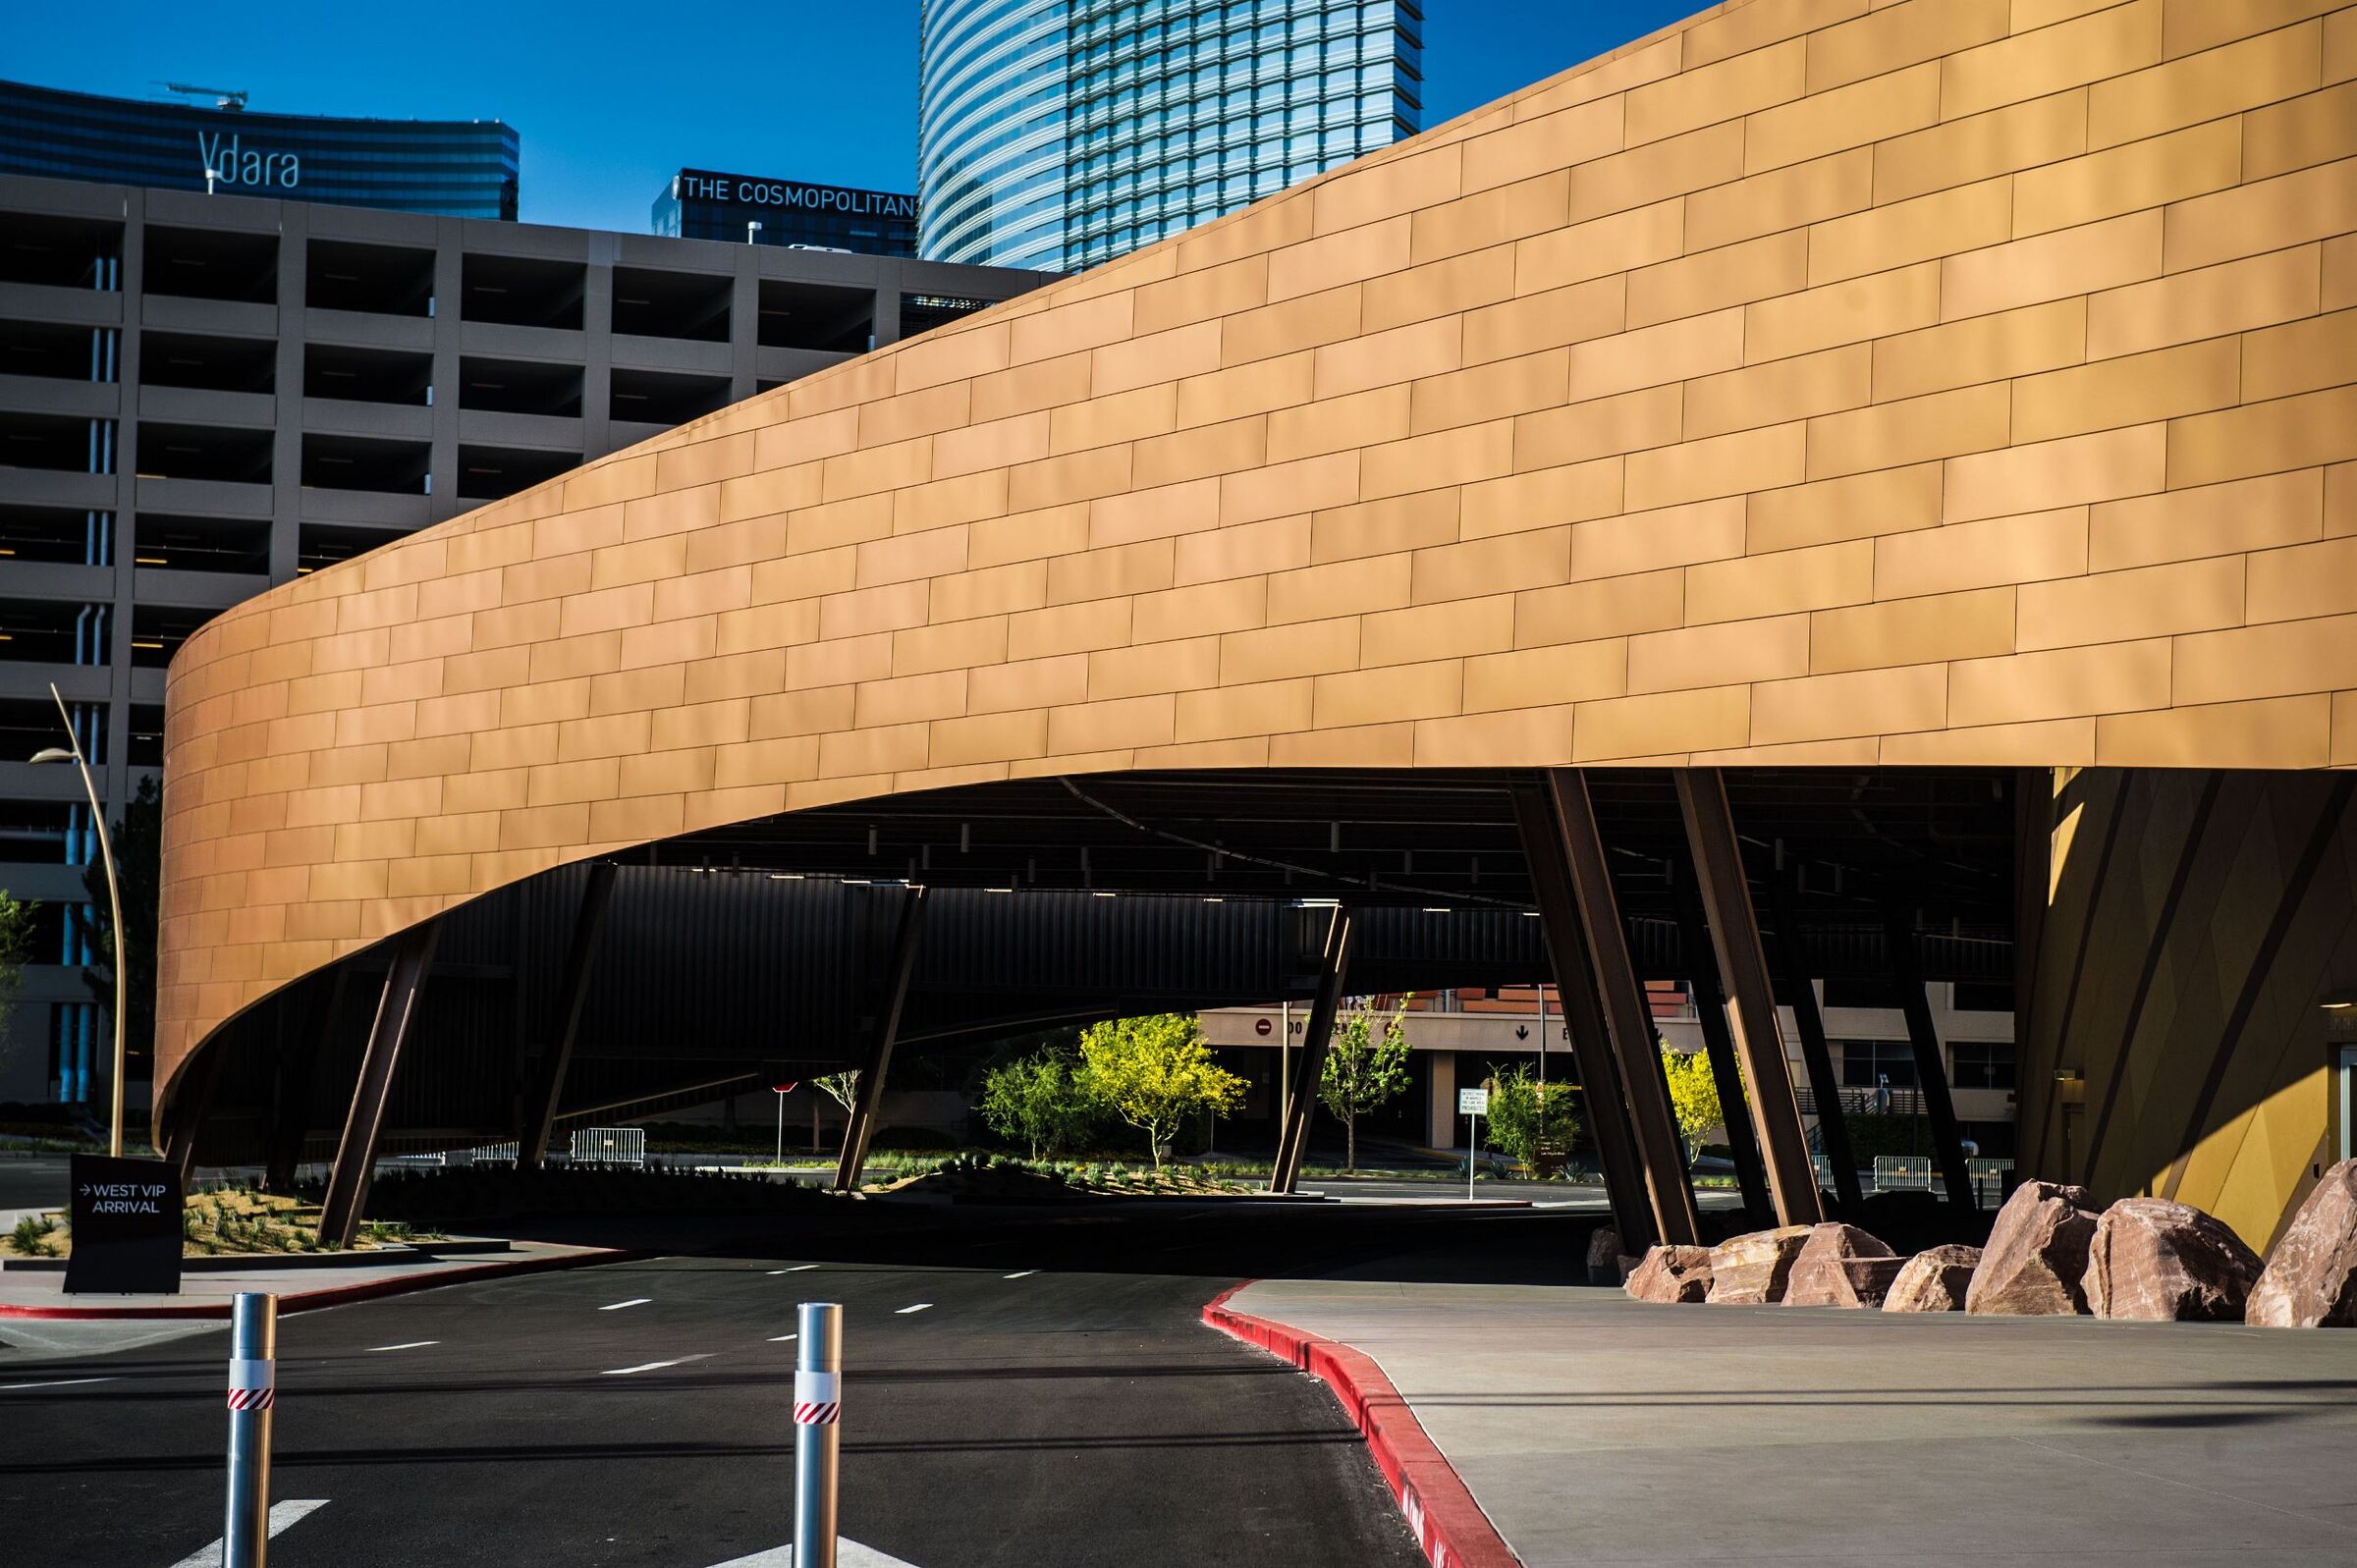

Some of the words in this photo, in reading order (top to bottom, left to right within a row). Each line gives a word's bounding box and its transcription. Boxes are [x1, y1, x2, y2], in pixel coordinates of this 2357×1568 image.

[198, 132, 299, 188] Vdara
[684, 177, 730, 200] THE
[739, 182, 915, 217] COSMOPOLITAN
[93, 1184, 138, 1197] WEST
[141, 1185, 166, 1197] VIP
[92, 1201, 160, 1214] ARRIVAL
